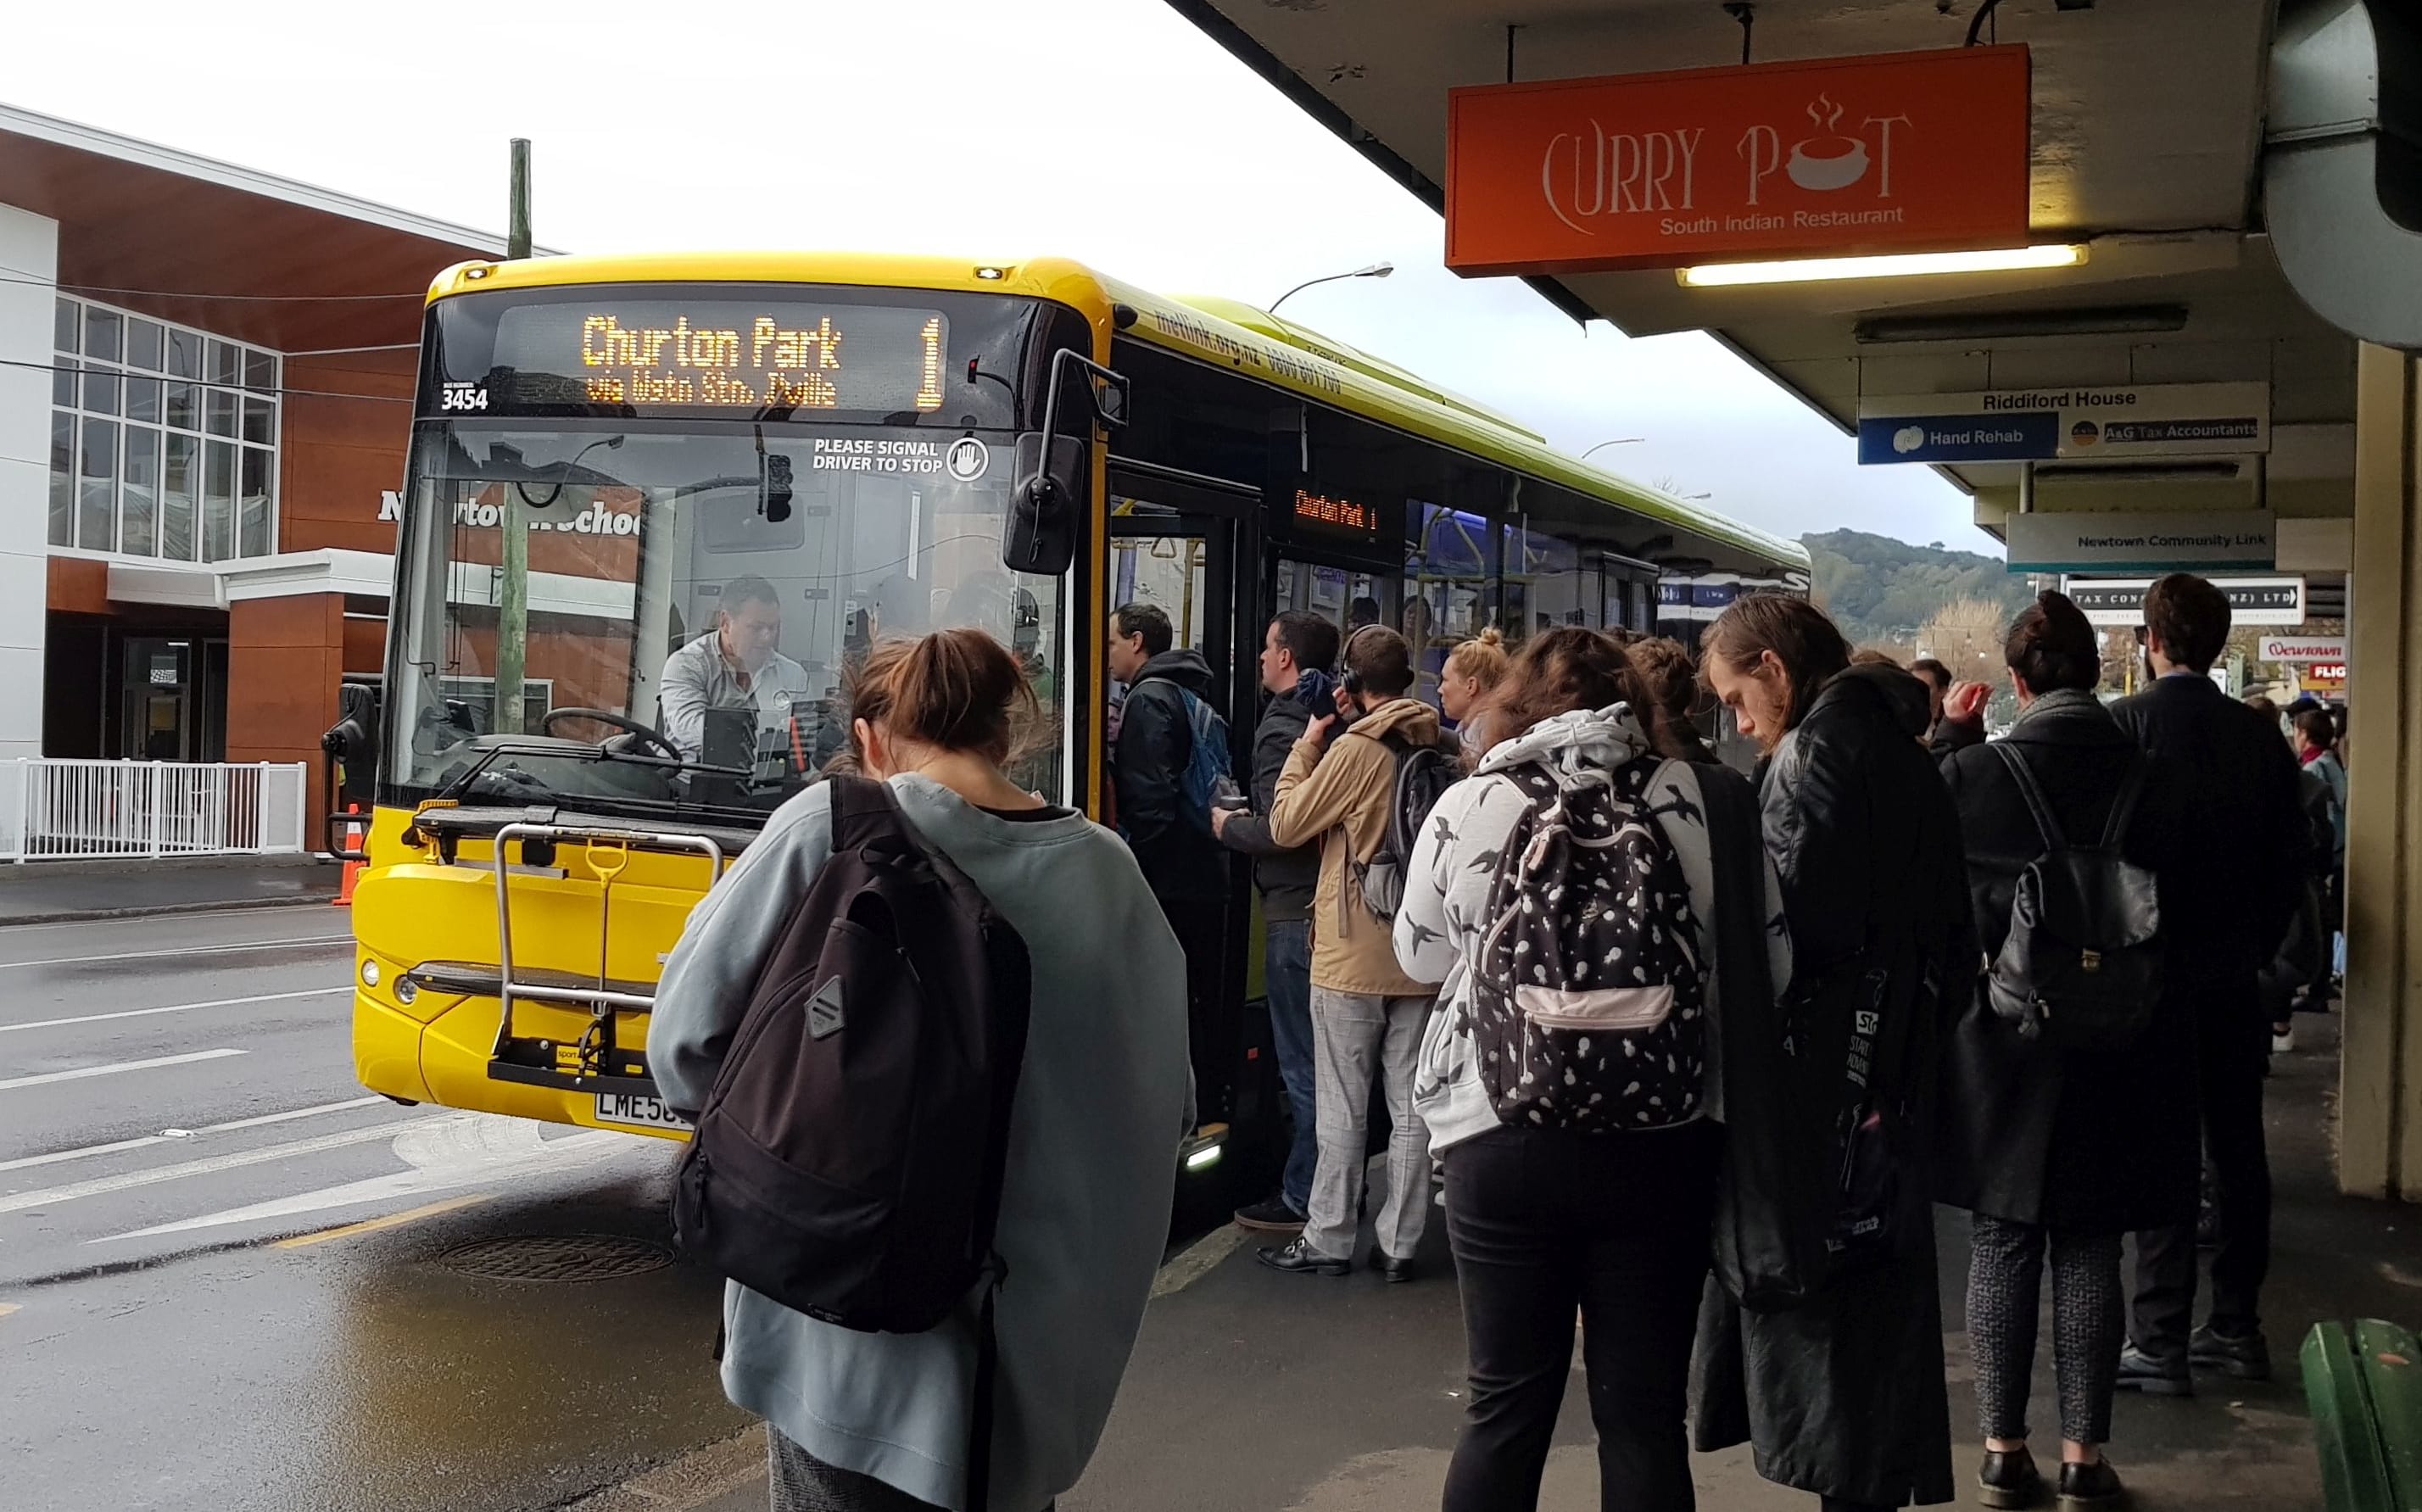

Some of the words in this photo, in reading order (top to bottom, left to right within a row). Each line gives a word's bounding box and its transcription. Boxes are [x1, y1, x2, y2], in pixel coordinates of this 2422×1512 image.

[1542, 118, 1705, 236] CURRY
[1660, 217, 1718, 236] South
[1725, 214, 1785, 232] Indian
[1793, 206, 1904, 228] Restaurant
[1153, 309, 1262, 367] metlink.org.nz
[583, 315, 740, 367] Churton
[752, 316, 842, 369] Park
[915, 317, 944, 409] 1
[441, 388, 489, 410] 3454
[1984, 393, 2070, 410] Riddiford
[2076, 391, 2137, 407] House
[1930, 431, 1970, 445] Hand
[1974, 429, 2024, 444] Rehab
[2138, 426, 2163, 438] Tax
[2166, 423, 2257, 438] Accountants
[814, 438, 873, 455] PLEASE
[875, 440, 939, 457] SIGNAL
[812, 455, 873, 471] DRIVER
[875, 458, 899, 473] TO
[901, 459, 944, 474] STOP
[2078, 536, 2145, 548] Newtown
[2148, 534, 2232, 548] Community
[2235, 533, 2267, 546] Link
[2077, 595, 2103, 605] TAX
[2263, 594, 2291, 604] LTD
[2269, 642, 2342, 657] Newtown
